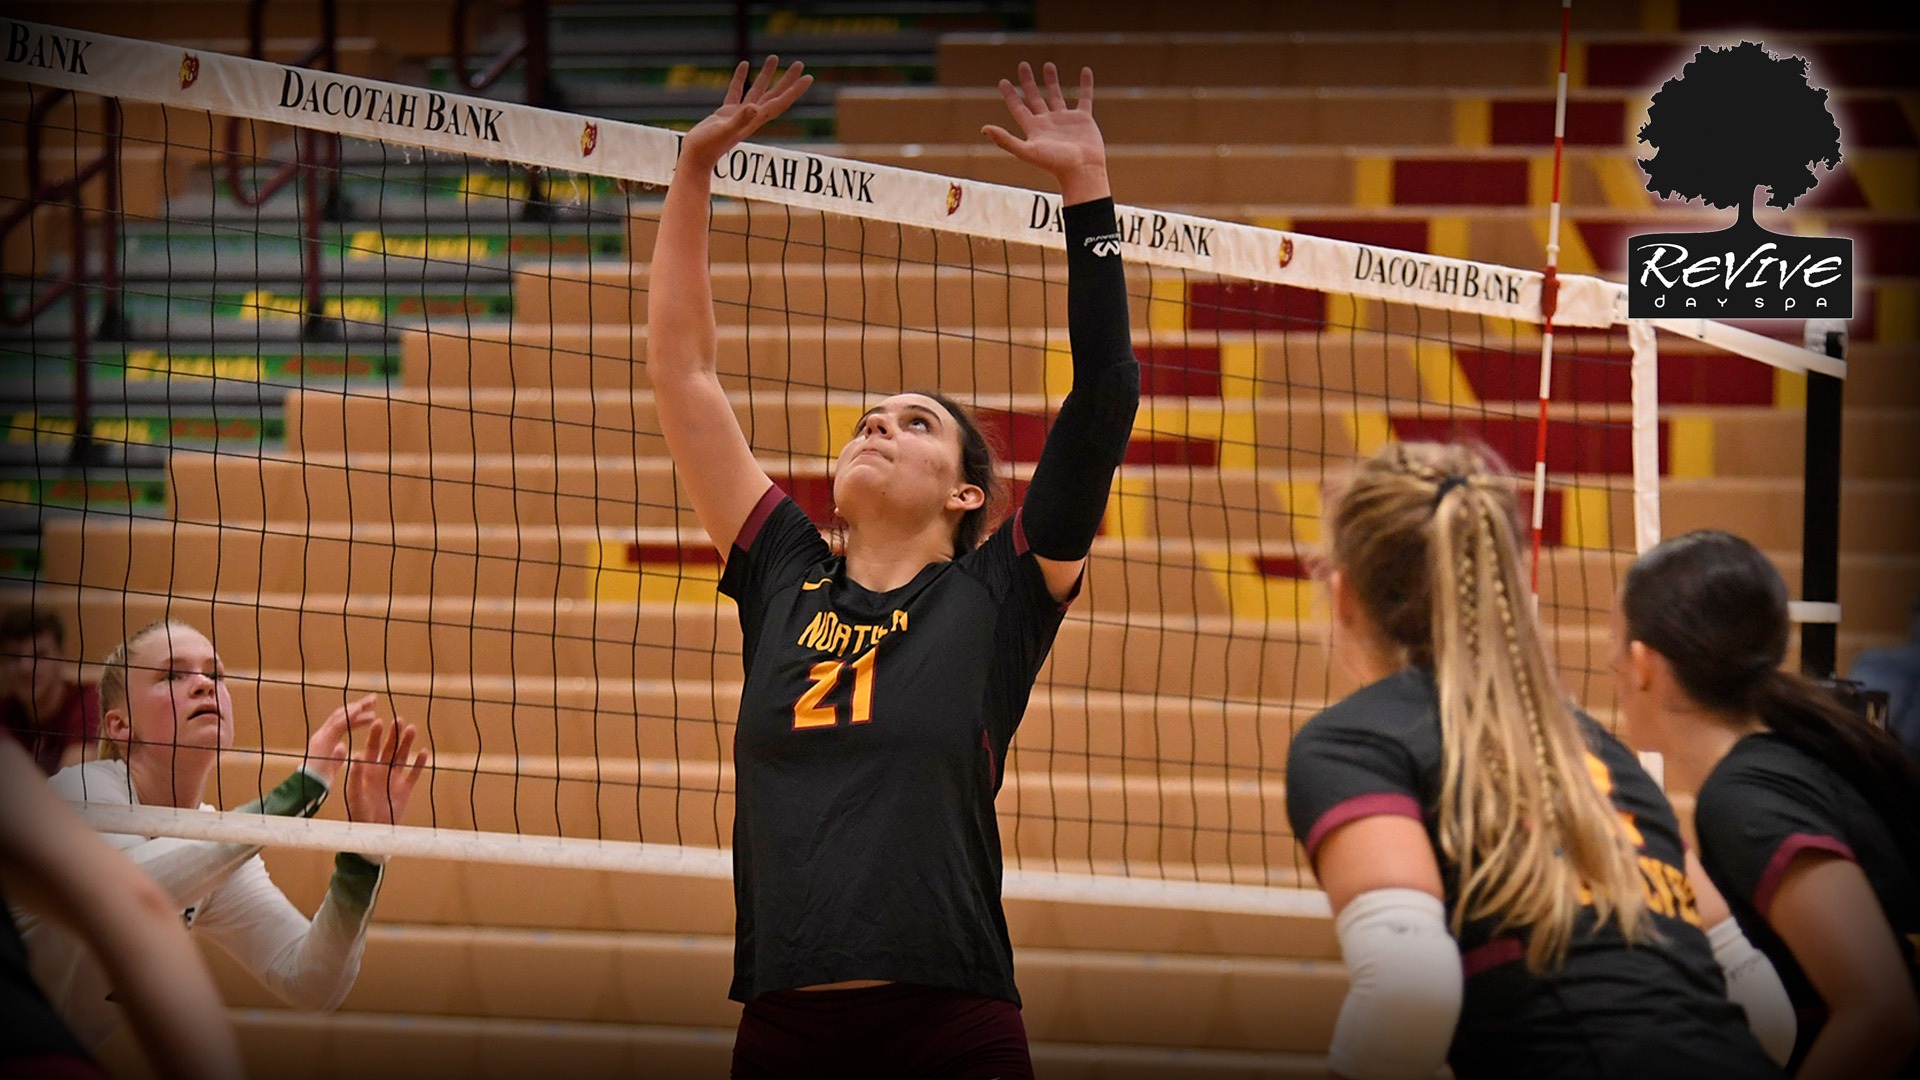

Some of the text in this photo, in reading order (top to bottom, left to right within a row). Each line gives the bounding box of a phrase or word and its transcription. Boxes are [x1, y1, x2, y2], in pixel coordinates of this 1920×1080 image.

[5, 22, 93, 75] BANK
[279, 68, 504, 143] DACOTAH BANK
[673, 135, 875, 203] COTAH BANK
[1029, 194, 1214, 257] DAAH BANK
[1354, 246, 1459, 295] DACOTAH
[792, 644, 880, 730] 21
